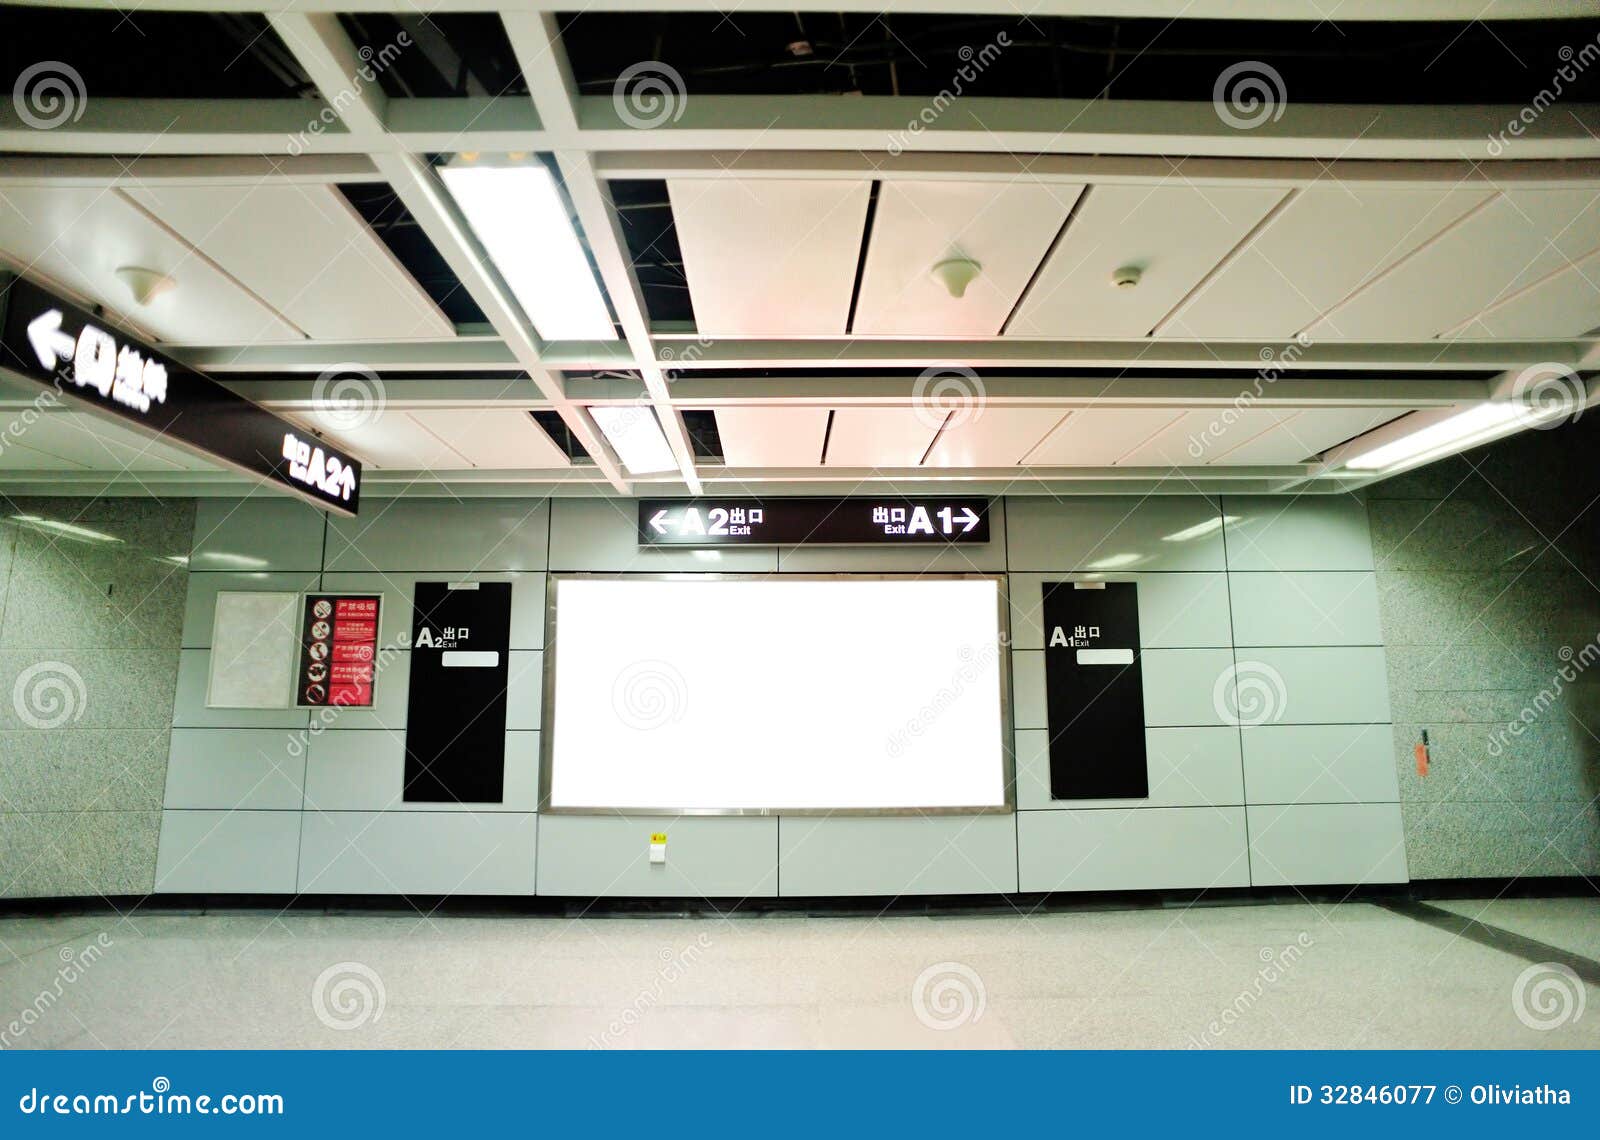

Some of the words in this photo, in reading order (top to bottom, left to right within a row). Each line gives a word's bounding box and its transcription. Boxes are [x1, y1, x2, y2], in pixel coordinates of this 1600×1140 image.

[680, 507, 729, 535] A2
[730, 507, 763, 525] 出口
[873, 506, 906, 524] 出口
[730, 525, 751, 535] Exit
[884, 524, 906, 535] Exit
[415, 627, 443, 648] A2
[443, 626, 469, 640] 出口
[1049, 626, 1075, 648] A1
[1074, 625, 1100, 639] 出口
[442, 640, 457, 649] Exit
[1075, 639, 1090, 648] Exit
